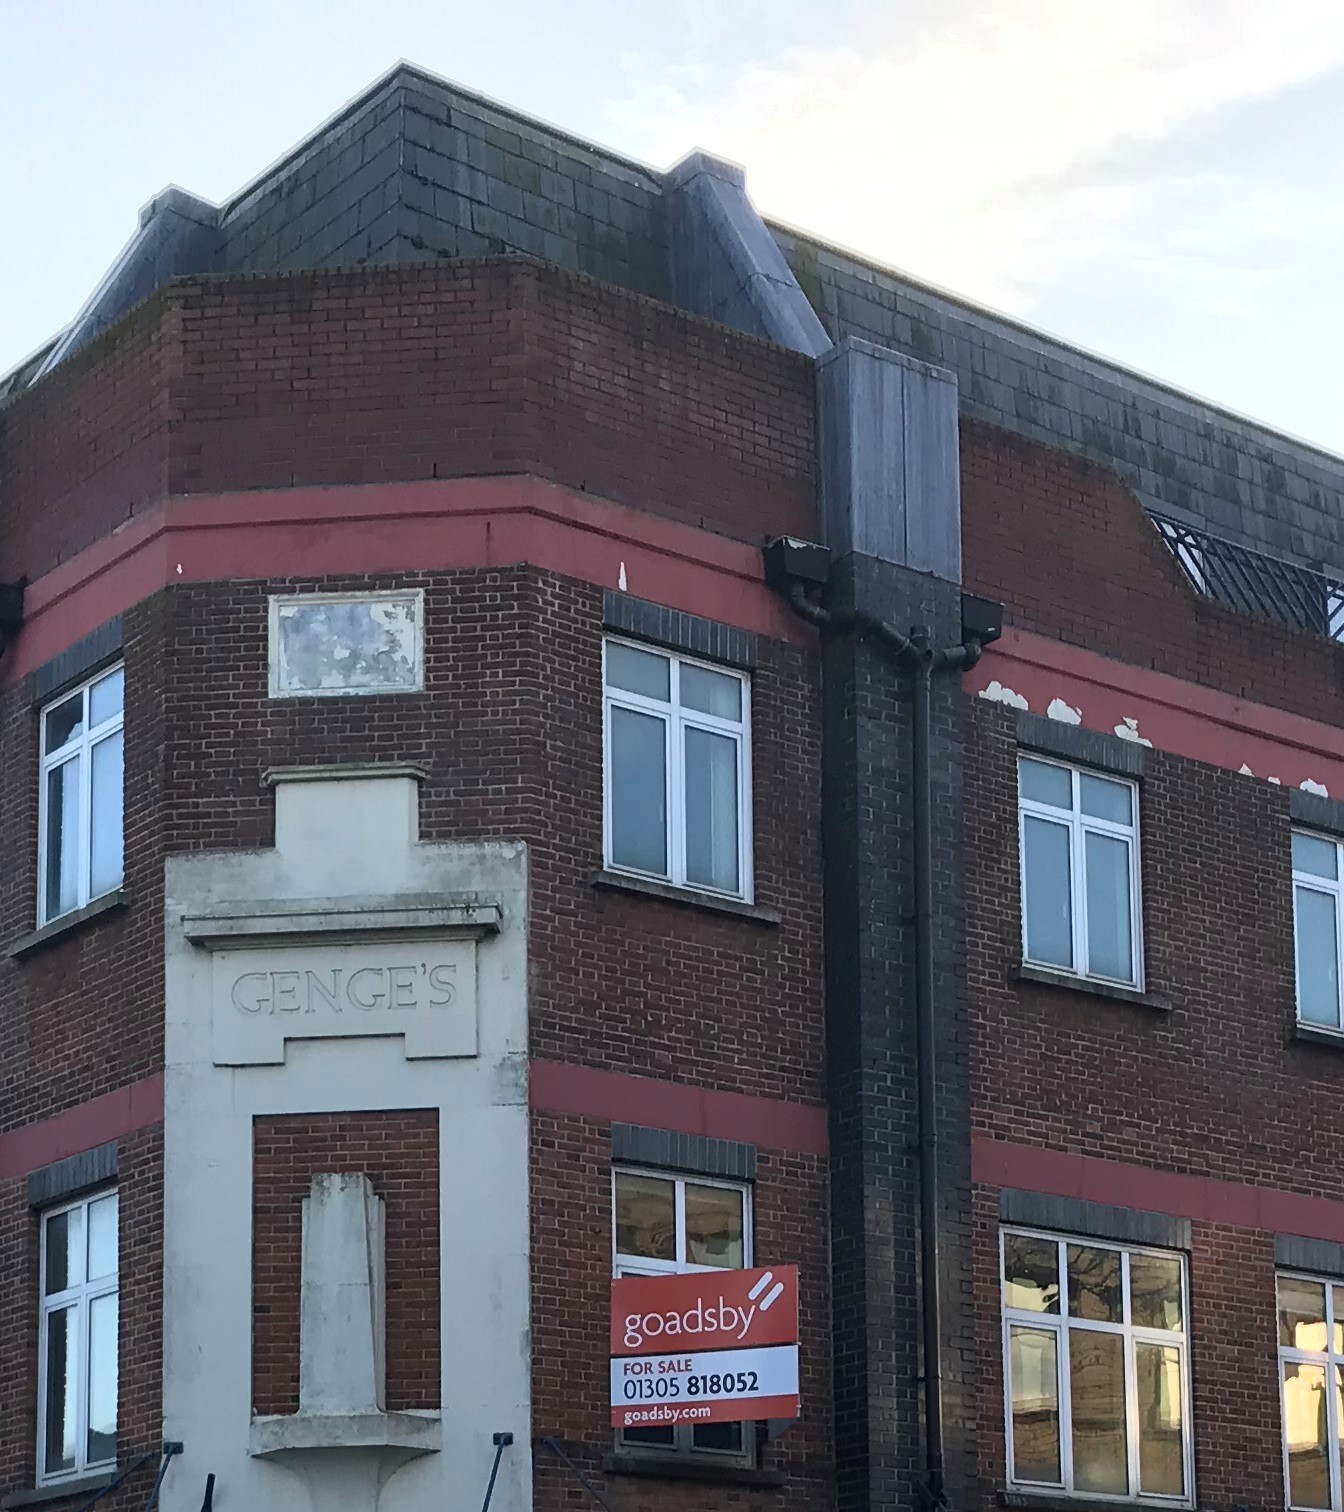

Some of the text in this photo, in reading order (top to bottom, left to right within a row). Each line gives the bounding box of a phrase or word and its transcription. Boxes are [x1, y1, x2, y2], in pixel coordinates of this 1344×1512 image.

[231, 962, 457, 1015] GENGE'S
[623, 1296, 756, 1348] goadsby
[623, 1359, 693, 1376] FOR SALE
[624, 1371, 759, 1399] 01305 818052
[624, 1406, 711, 1425] goadsby.com
